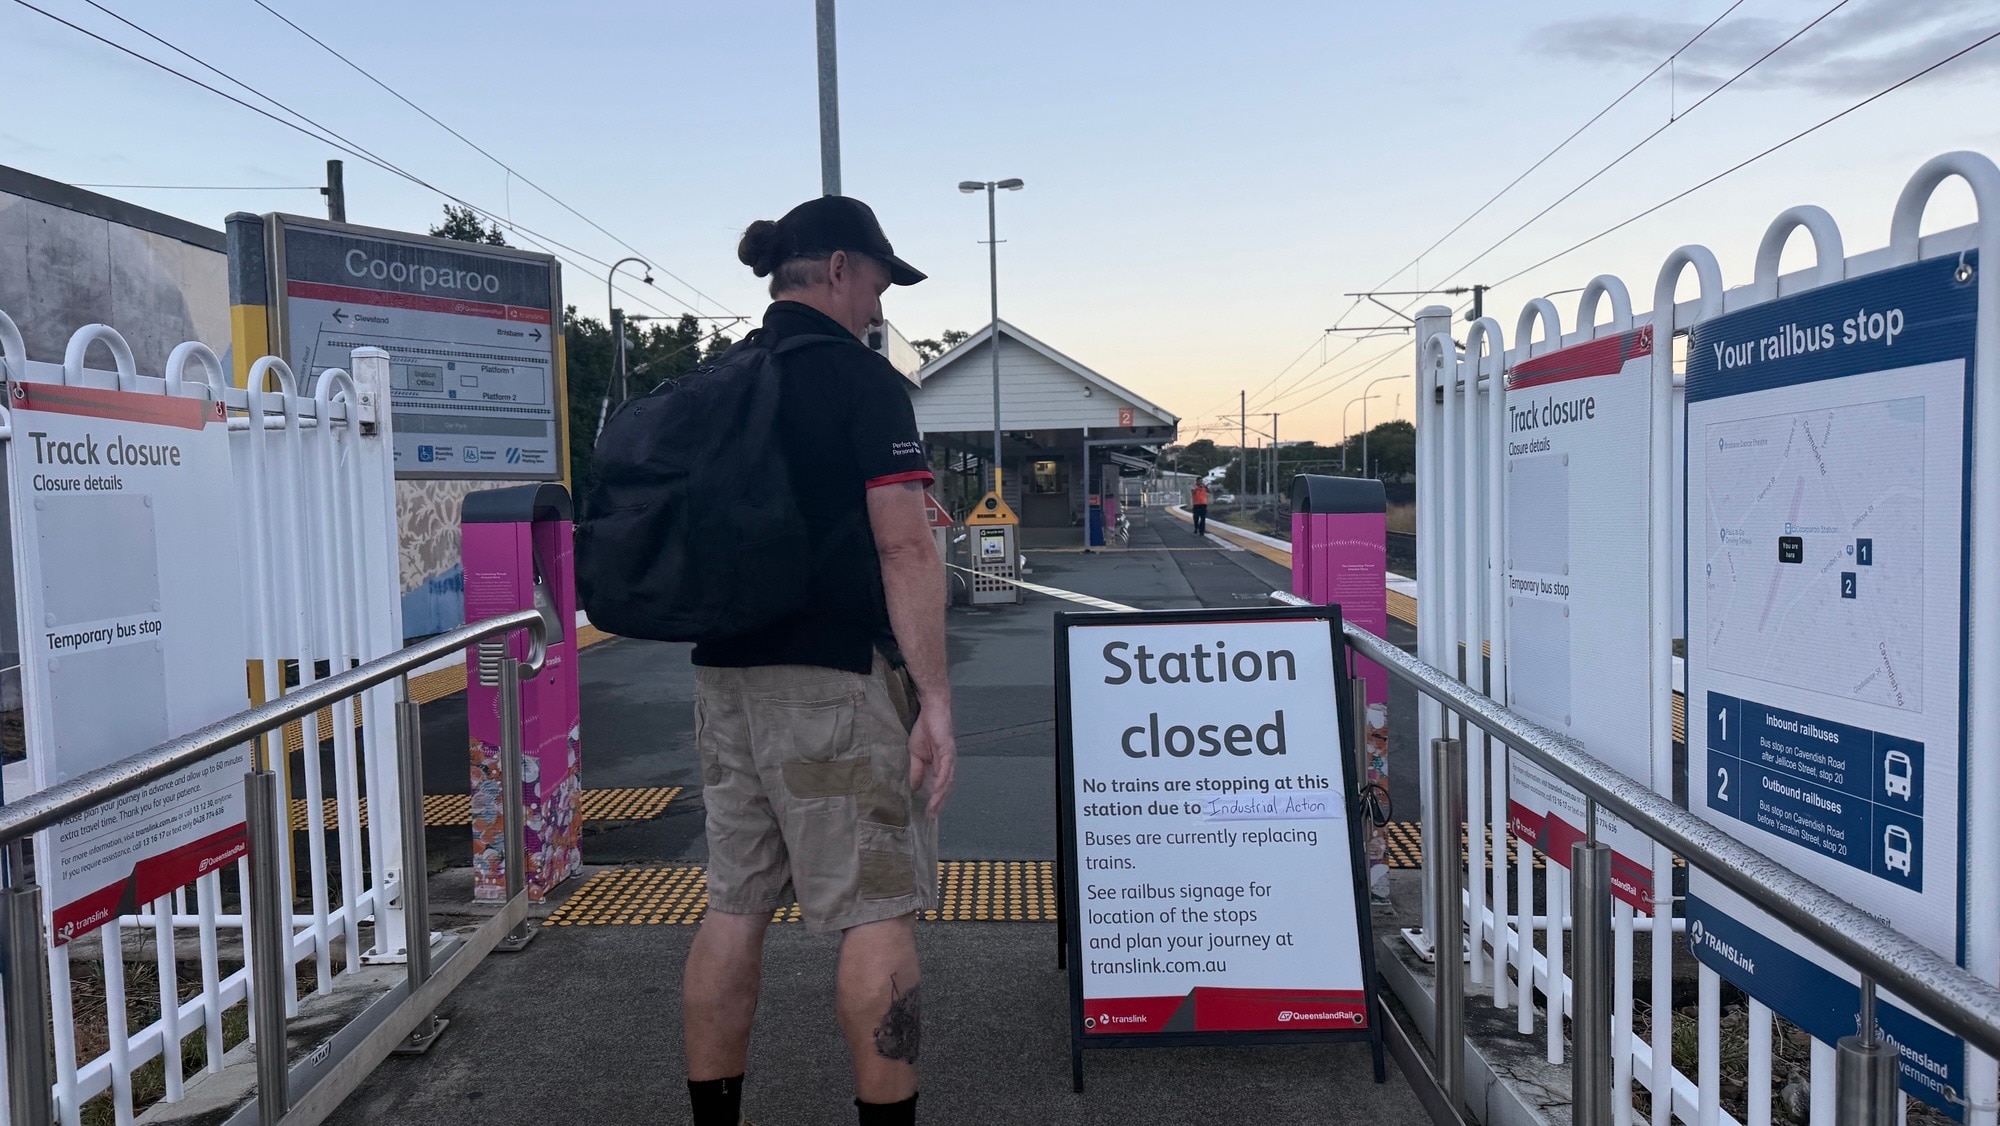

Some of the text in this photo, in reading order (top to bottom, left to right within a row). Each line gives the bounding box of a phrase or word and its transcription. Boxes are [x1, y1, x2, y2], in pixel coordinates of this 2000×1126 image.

[345, 249, 499, 293] Coorparoo
[354, 314, 390, 324] Cleveland
[497, 328, 524, 337] Brisbane
[1713, 308, 1904, 371] Your railbus stop
[481, 365, 510, 374] Platform
[482, 392, 511, 401] Platform
[1122, 413, 1130, 424] 2
[1509, 396, 1595, 433] Track closure
[29, 431, 181, 466] Track closure
[892, 441, 911, 449] Perfect
[892, 448, 914, 456] Personal
[1509, 436, 1551, 456] Closure details
[1803, 420, 1827, 476] Cavendish Rd
[33, 474, 123, 491] Closure details
[1862, 546, 1866, 560] 1
[1509, 575, 1569, 599] Temporary bus stop
[1845, 580, 1852, 594] 2
[46, 619, 162, 650] Temporary bus stop
[1102, 640, 1297, 685] Station
[1879, 642, 1904, 707] Cavendish Rd
[1121, 710, 1287, 759] closed
[1718, 708, 1727, 740] 1
[1766, 712, 1839, 744] Inbound railbuses
[1760, 736, 1846, 770] Bus stop on Cavendish Road
[1761, 751, 1843, 785] after Jellicoe Street, stop 20
[84, 755, 244, 821] plan your journey in advance and allow up to 60 minutes
[1083, 775, 1329, 795] No trains are stopping at this
[1717, 767, 1728, 801] 2
[1762, 776, 1842, 814] Outbound railbuses
[60, 785, 201, 843] extra travel time. Thank you for your patience.
[1083, 800, 1201, 817] station due to
[1208, 796, 1326, 817] Industrial Action
[1521, 823, 1536, 839] translink
[1759, 800, 1844, 840] Bus stop on Cavendish Road
[61, 857, 71, 866] For
[73, 851, 88, 862] more
[89, 838, 123, 855] information,
[124, 831, 135, 841] visit
[135, 815, 178, 836] translink.com.au
[184, 807, 193, 817] call
[193, 805, 200, 814] 13
[200, 802, 206, 810] 12
[1085, 828, 1318, 848] Buses are currently replacing
[1757, 813, 1847, 856] before Yarrabin Street, stop 20
[62, 870, 69, 880] If
[69, 867, 81, 880] you
[81, 859, 101, 873] require
[132, 839, 142, 851] call
[143, 838, 150, 846] 13
[150, 834, 158, 843] 16
[159, 831, 166, 840] 17
[172, 825, 182, 834] text
[182, 821, 192, 830] only
[193, 814, 205, 826] 0428
[208, 842, 245, 866] QueenslandRail
[1086, 855, 1136, 870] trains.
[1087, 881, 1272, 902] See railbus signage for
[76, 907, 109, 930] translink
[1089, 908, 1257, 926] location of the stops
[1090, 932, 1294, 952] and plan your journey at
[1705, 931, 1755, 974] TRANSLink
[1091, 957, 1227, 975] translink.com.au
[1112, 1011, 1353, 1024] translink QueenslandRail
